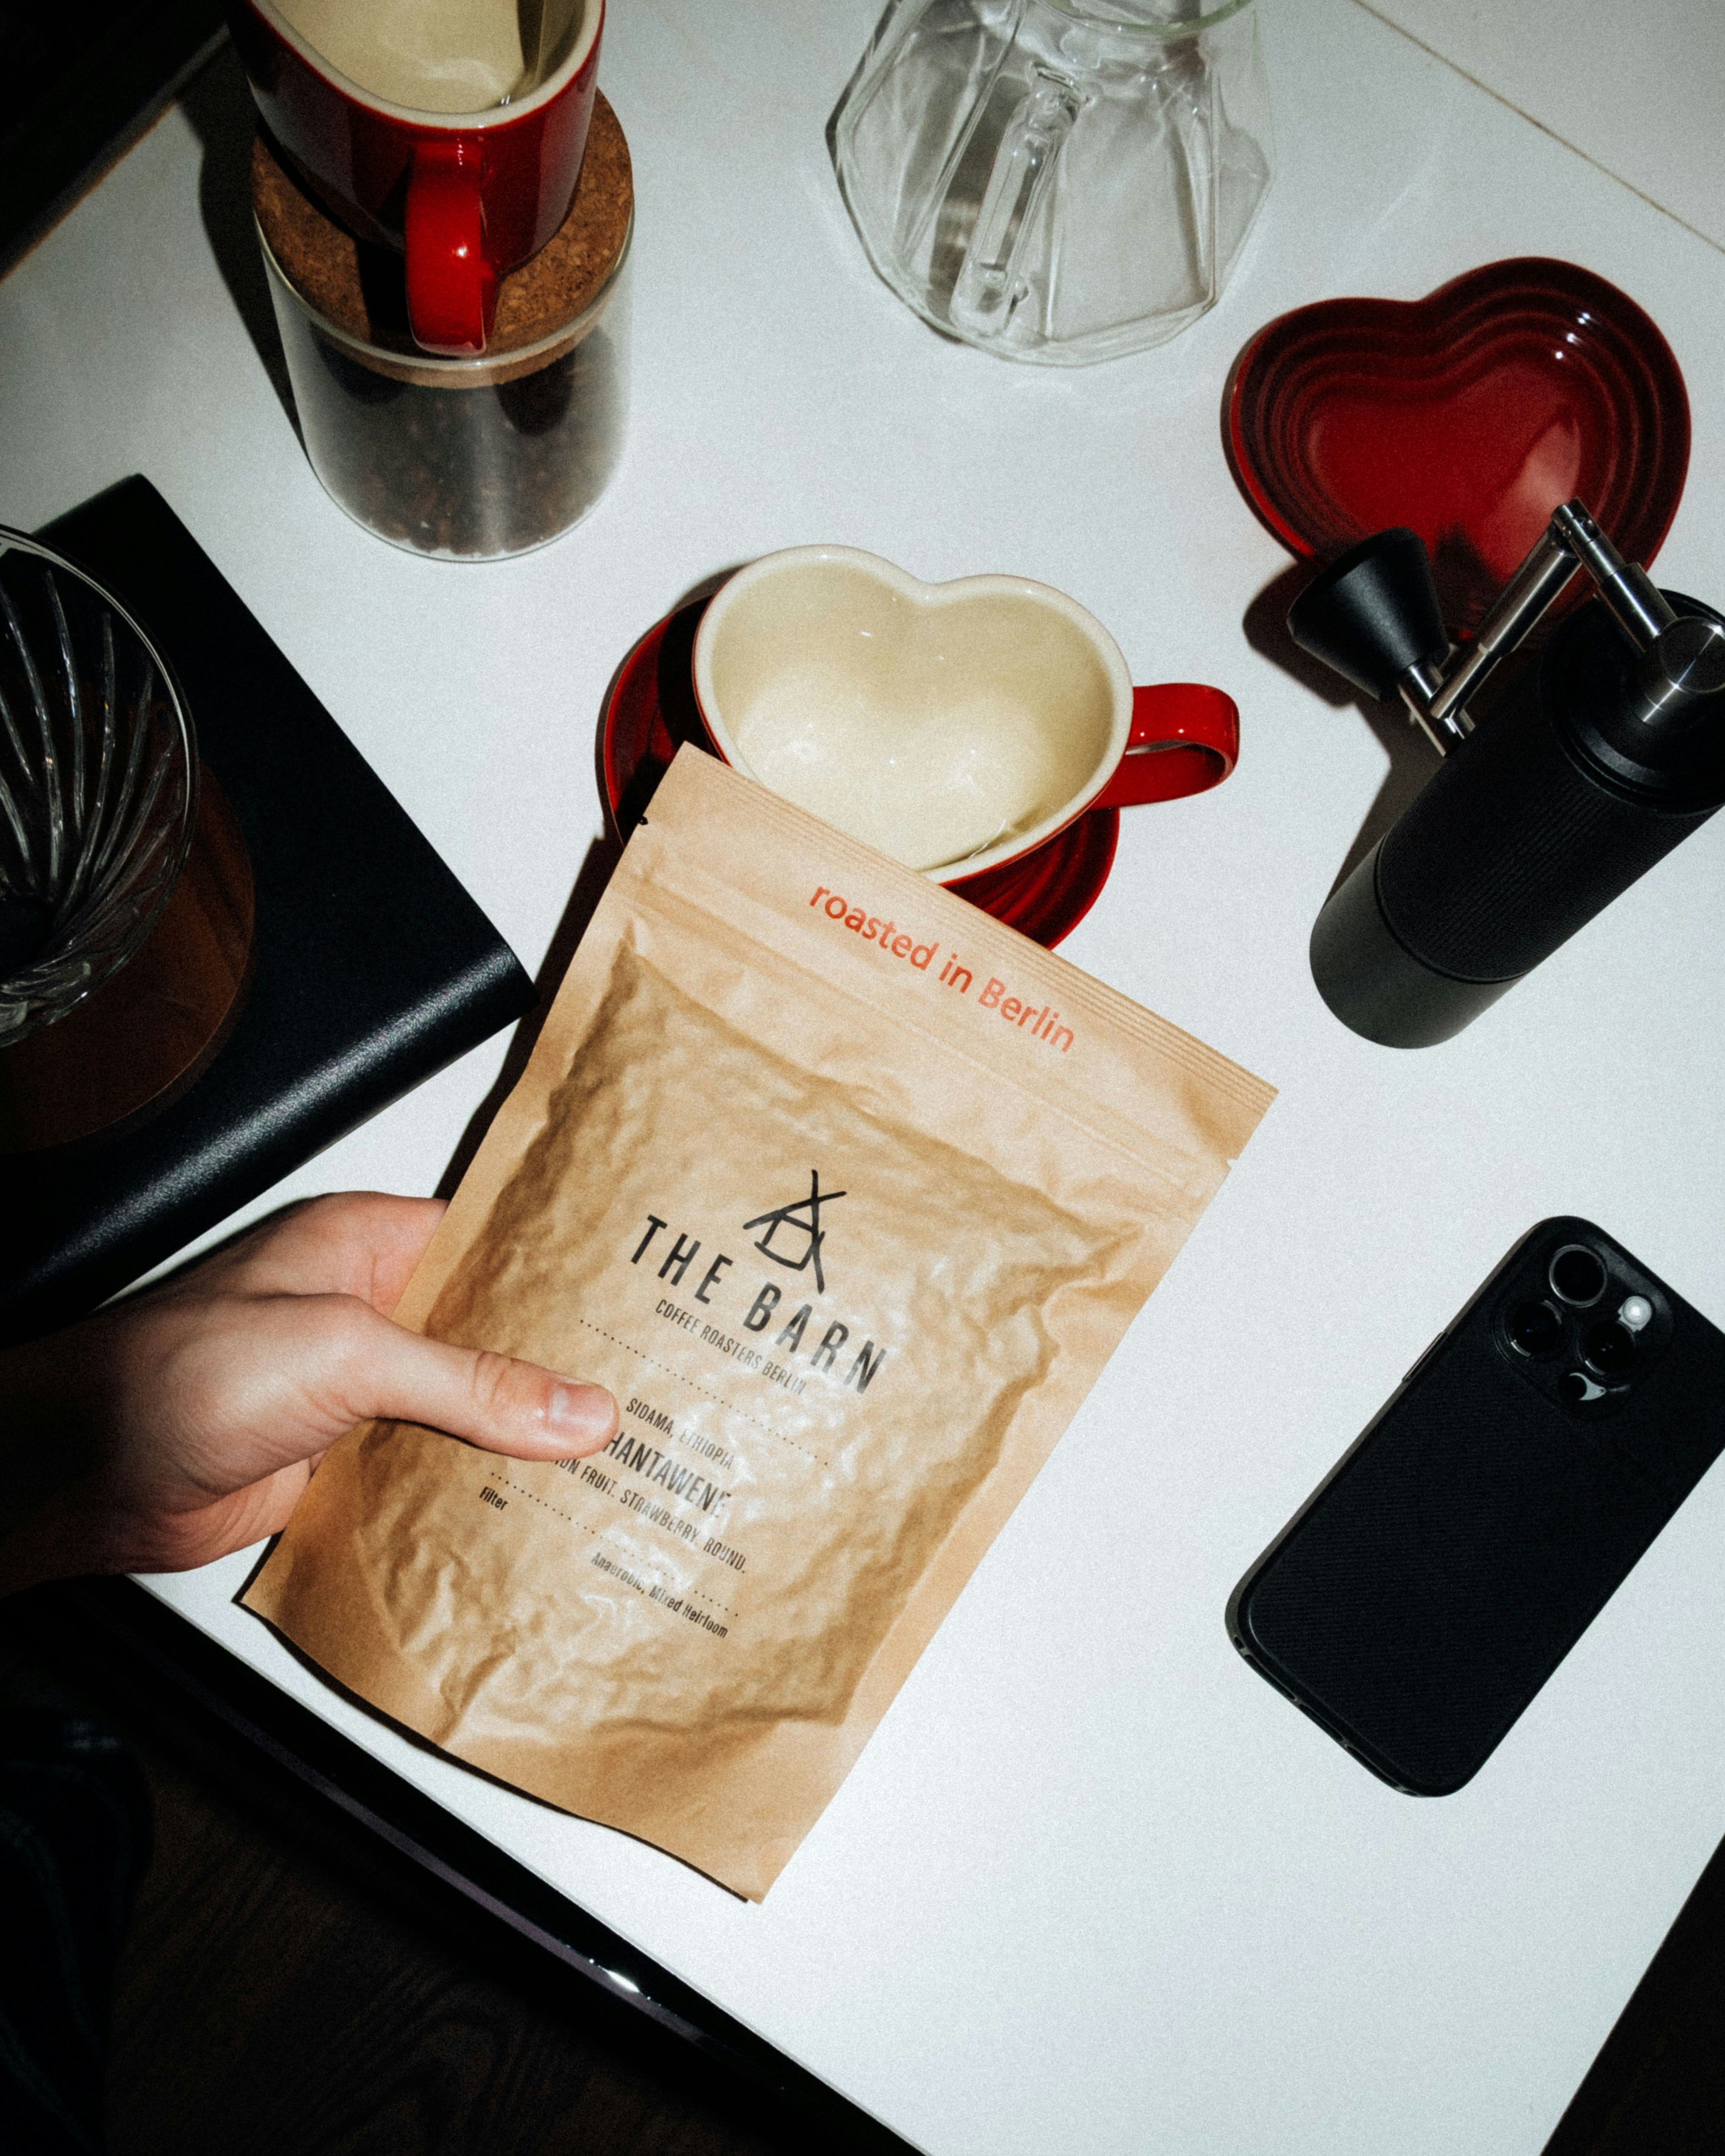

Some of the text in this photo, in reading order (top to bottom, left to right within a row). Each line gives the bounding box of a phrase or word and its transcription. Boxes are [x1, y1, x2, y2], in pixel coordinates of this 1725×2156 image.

[809, 886, 1075, 1053] roasted in Berlin
[631, 1214, 886, 1395] THE BARN
[655, 1299, 807, 1395] COFFEE ROASTERS BERLIN
[602, 1431, 732, 1518] HANTAWENE
[626, 1398, 734, 1470] SIDAMA, ETHIOPIA
[479, 1486, 508, 1510] Filter
[580, 1465, 617, 1497] FRUIT.
[703, 1538, 746, 1574] ROUND.
[591, 1552, 728, 1639] Anaerobic, Mixed Heirloom
